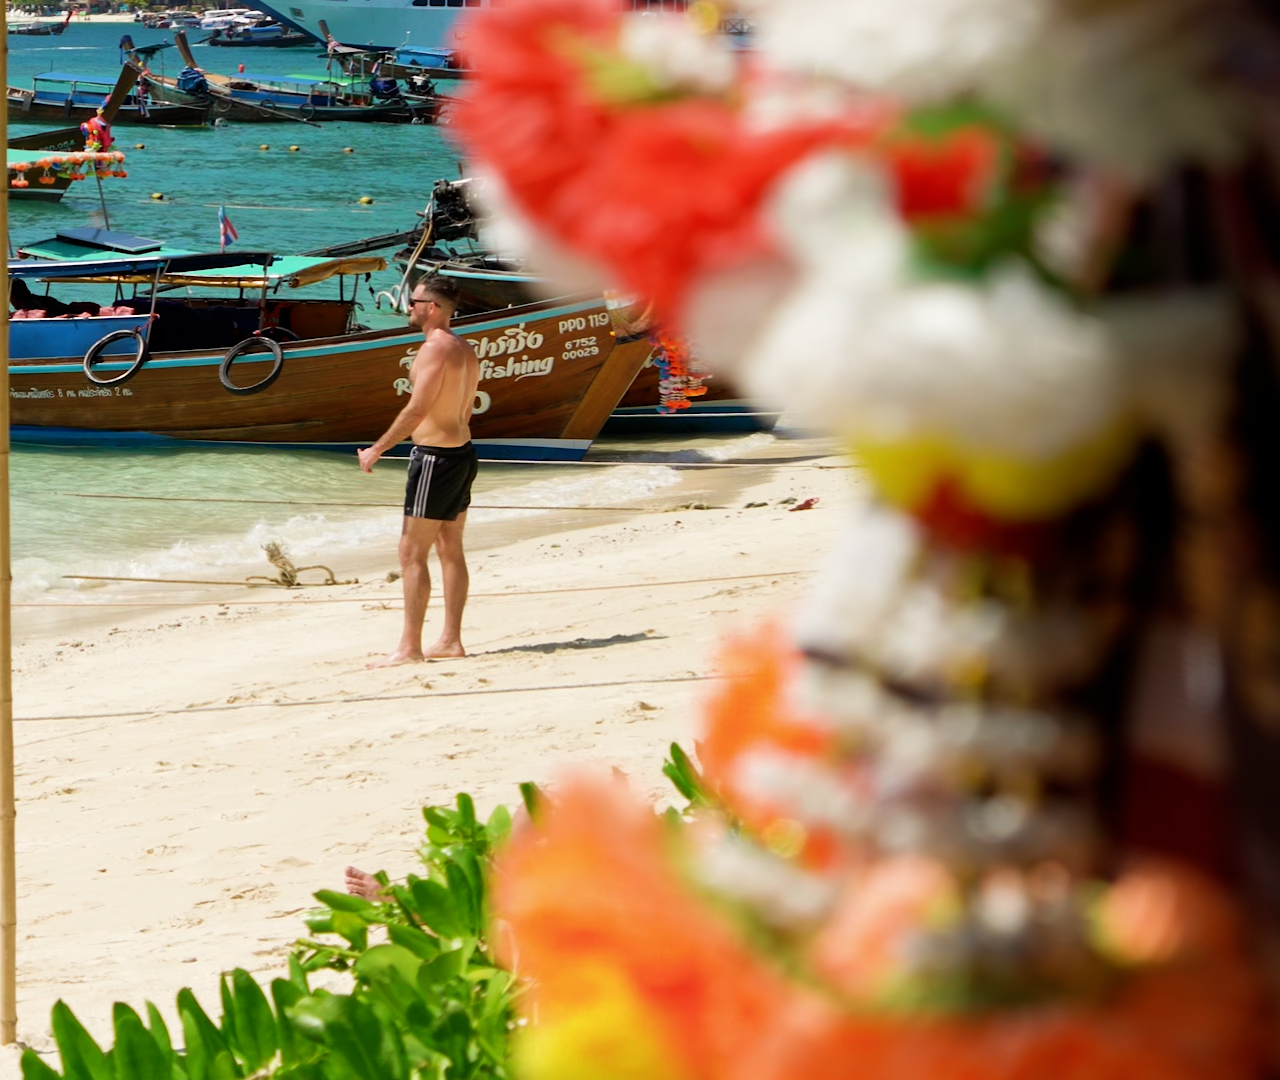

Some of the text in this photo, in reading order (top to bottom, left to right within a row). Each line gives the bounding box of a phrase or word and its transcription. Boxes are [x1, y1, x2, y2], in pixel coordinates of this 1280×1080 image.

[558, 312, 610, 334] PPD 119
[565, 336, 597, 350] 6752
[562, 346, 599, 360] 00029
[479, 354, 555, 382] fishing
